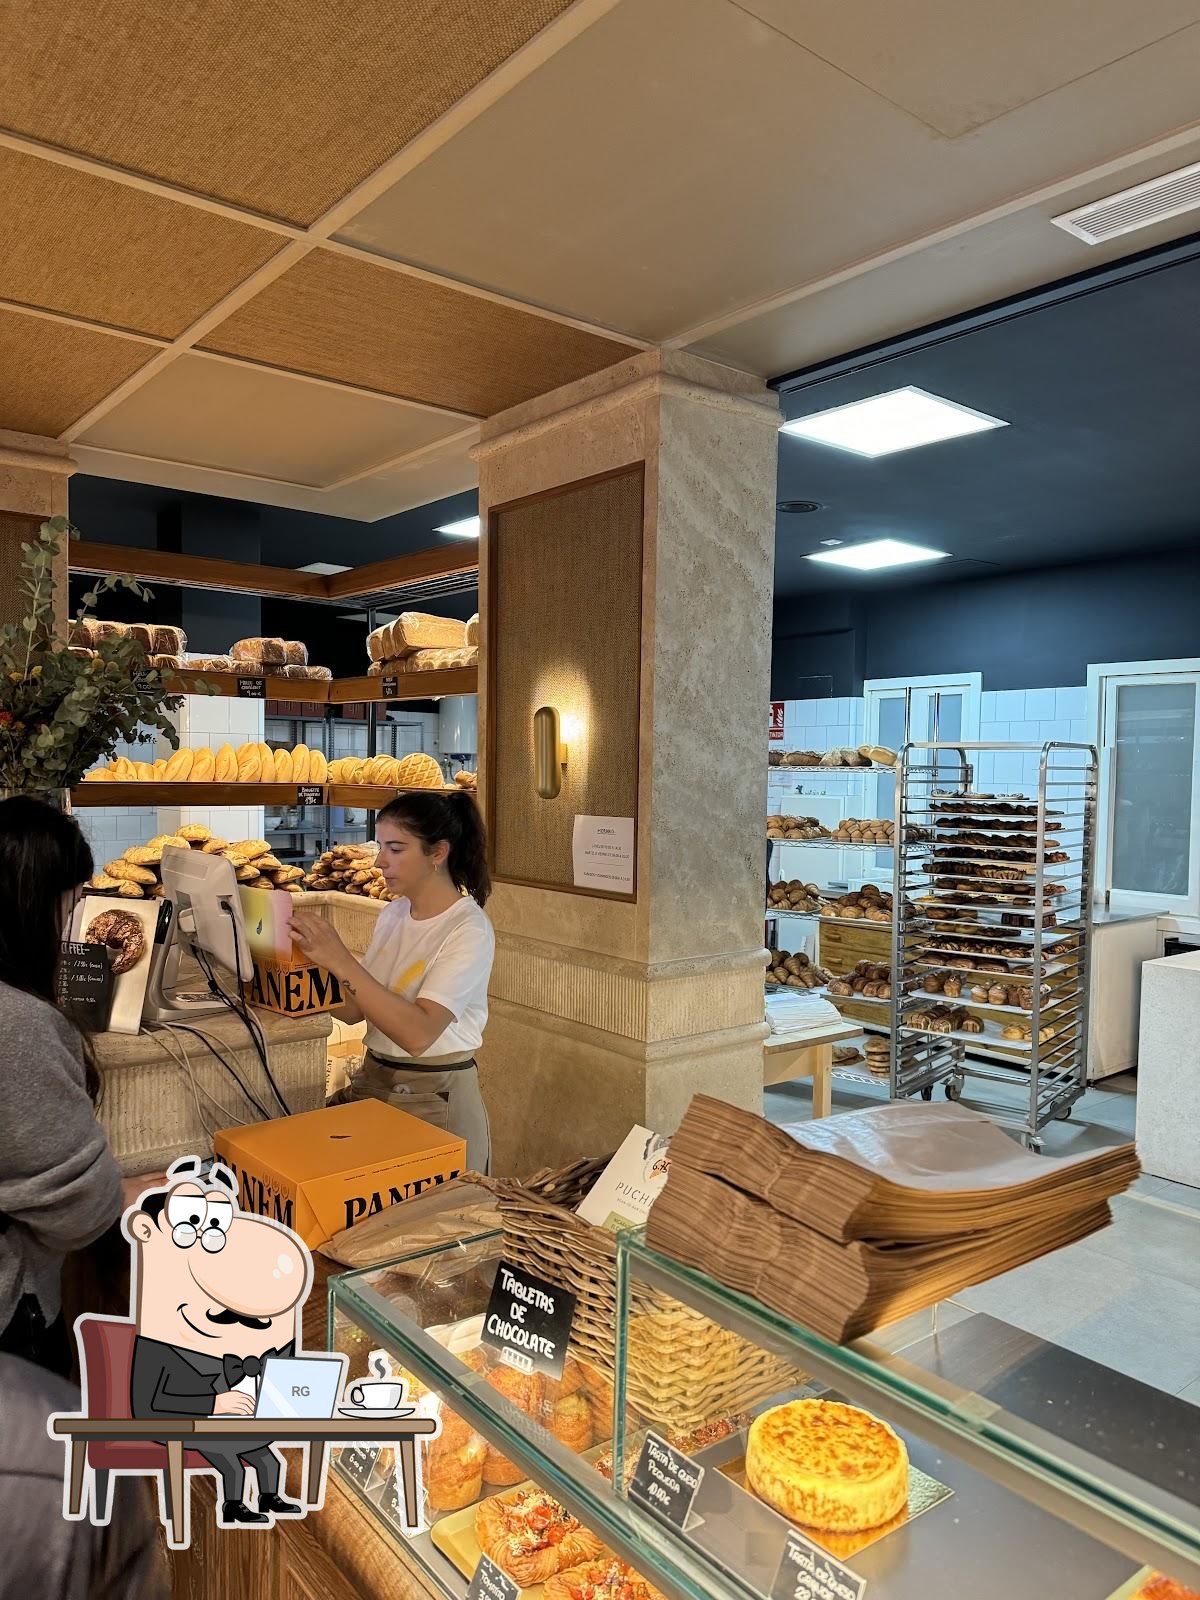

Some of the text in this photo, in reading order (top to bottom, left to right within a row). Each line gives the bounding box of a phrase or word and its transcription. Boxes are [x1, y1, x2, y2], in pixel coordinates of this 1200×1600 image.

[247, 962, 344, 1013] ANEM
[500, 1267, 555, 1315] TABLETAS
[509, 1302, 528, 1324] DE
[486, 1313, 556, 1360] CHOCOLATE
